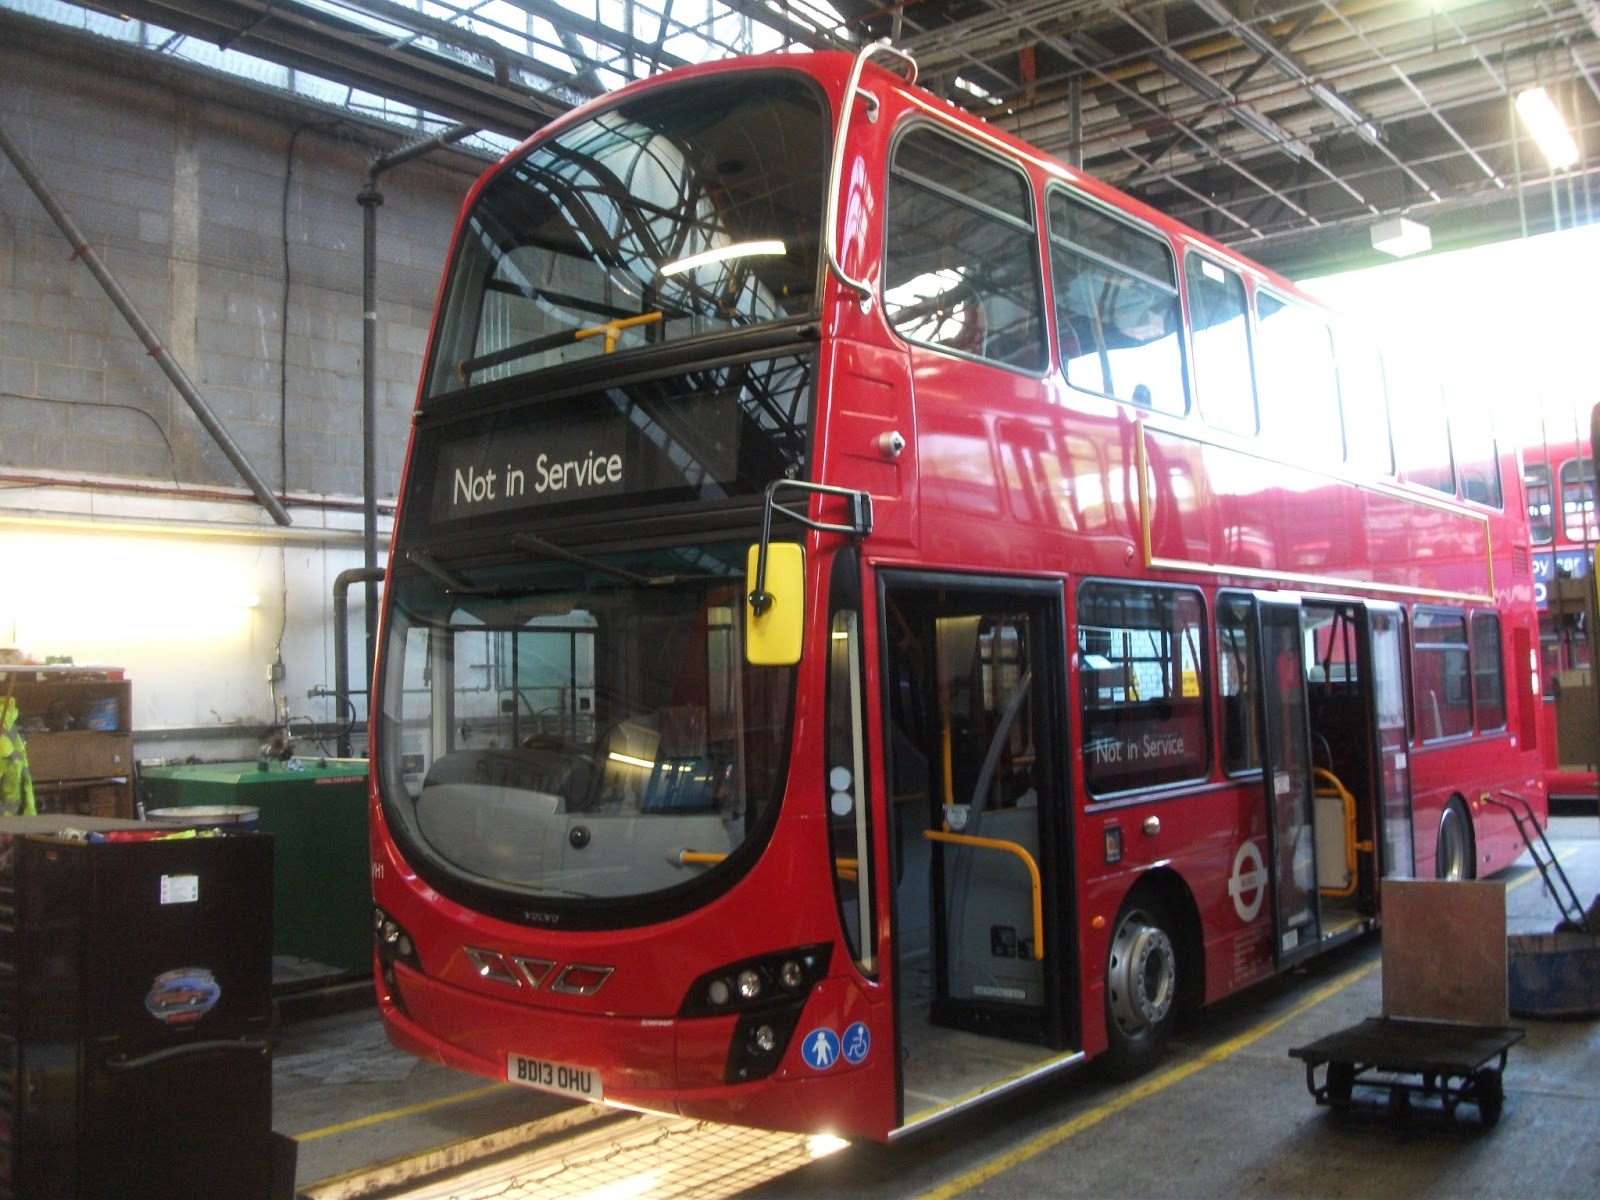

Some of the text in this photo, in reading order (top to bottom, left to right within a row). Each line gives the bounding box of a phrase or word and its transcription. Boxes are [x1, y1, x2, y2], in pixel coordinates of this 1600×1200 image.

[453, 450, 623, 504] Not in Service
[1096, 733, 1184, 764] Not in Service
[523, 911, 560, 924] VOLVO
[517, 1057, 591, 1094] BD13 OHU
